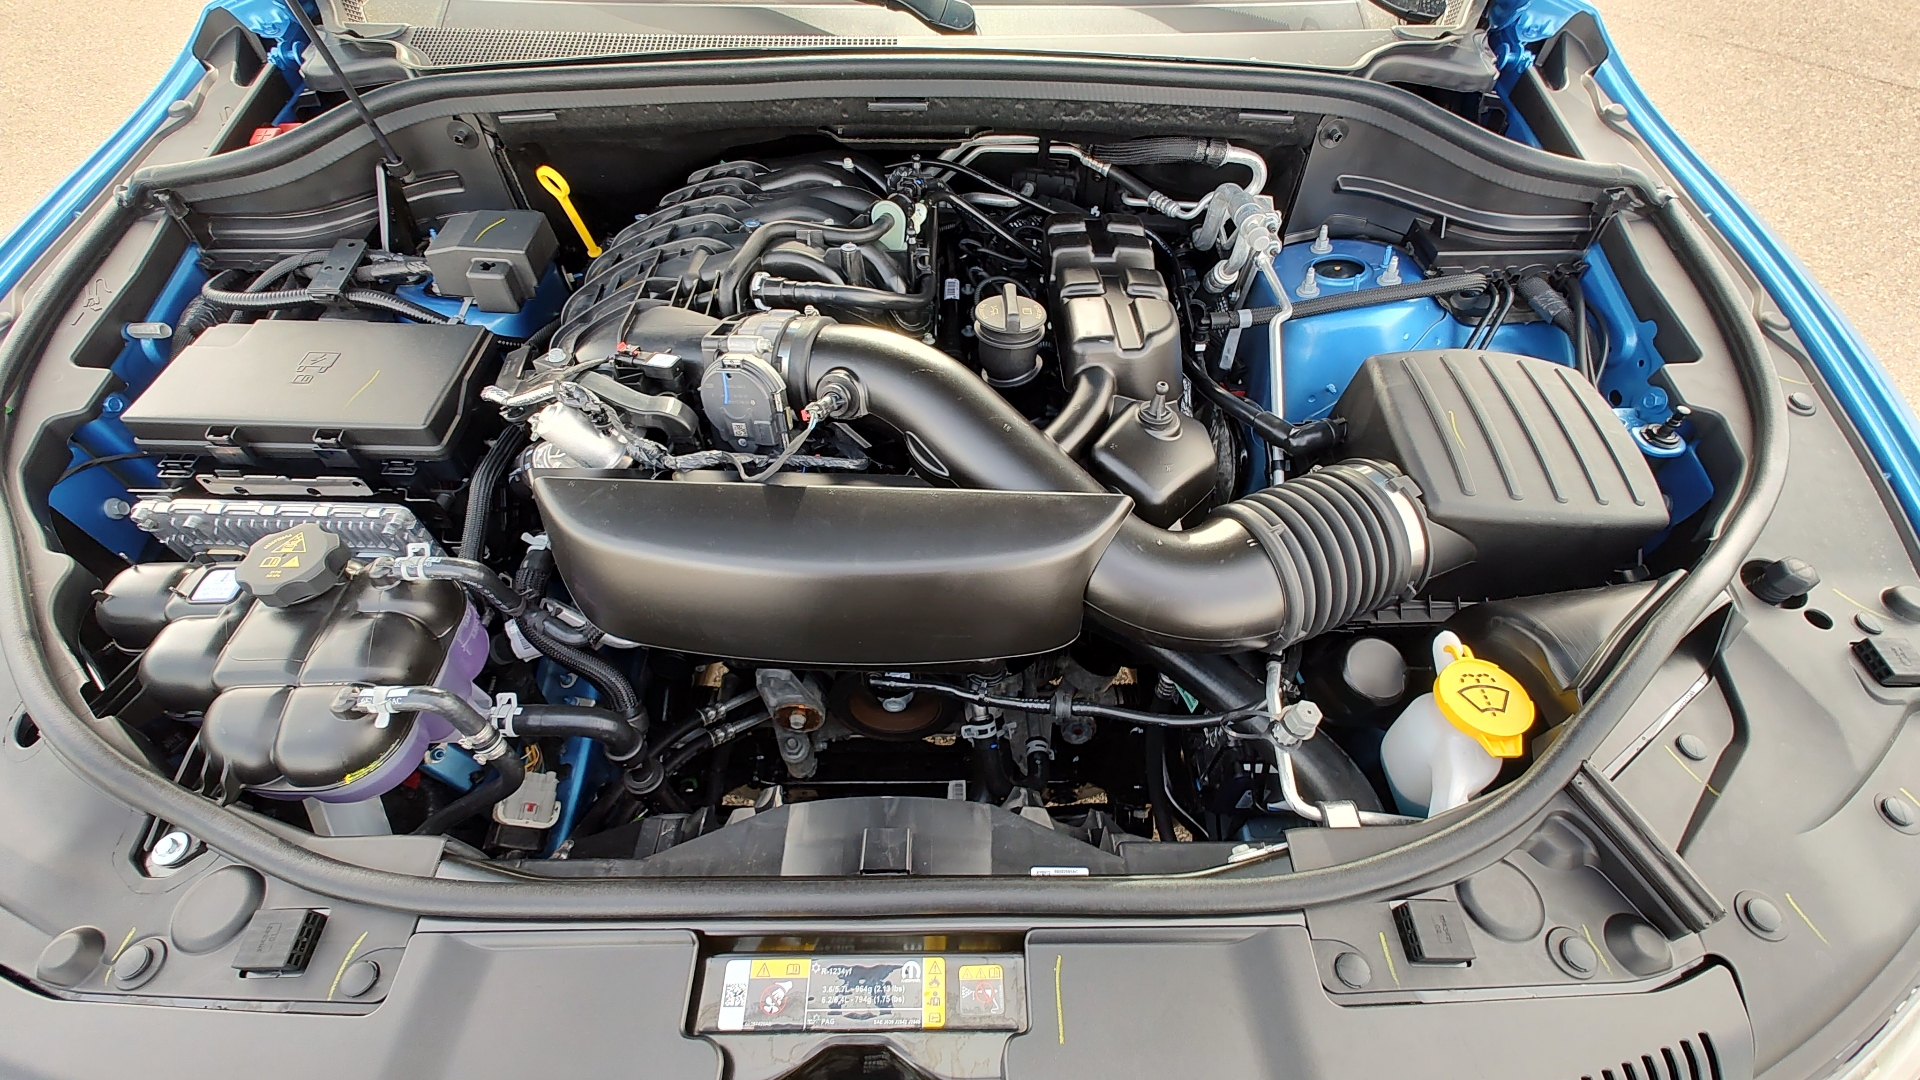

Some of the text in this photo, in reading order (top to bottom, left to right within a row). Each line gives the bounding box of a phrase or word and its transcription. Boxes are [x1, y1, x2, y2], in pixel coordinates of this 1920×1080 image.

[821, 967, 853, 977] R-1234yf
[822, 985, 849, 993] 3.6/5.7L
[855, 985, 873, 994] 964g
[874, 985, 891, 993] (2.13
[892, 985, 905, 993] lbs)
[855, 996, 872, 1004] 794g
[874, 996, 891, 1004] (1.75
